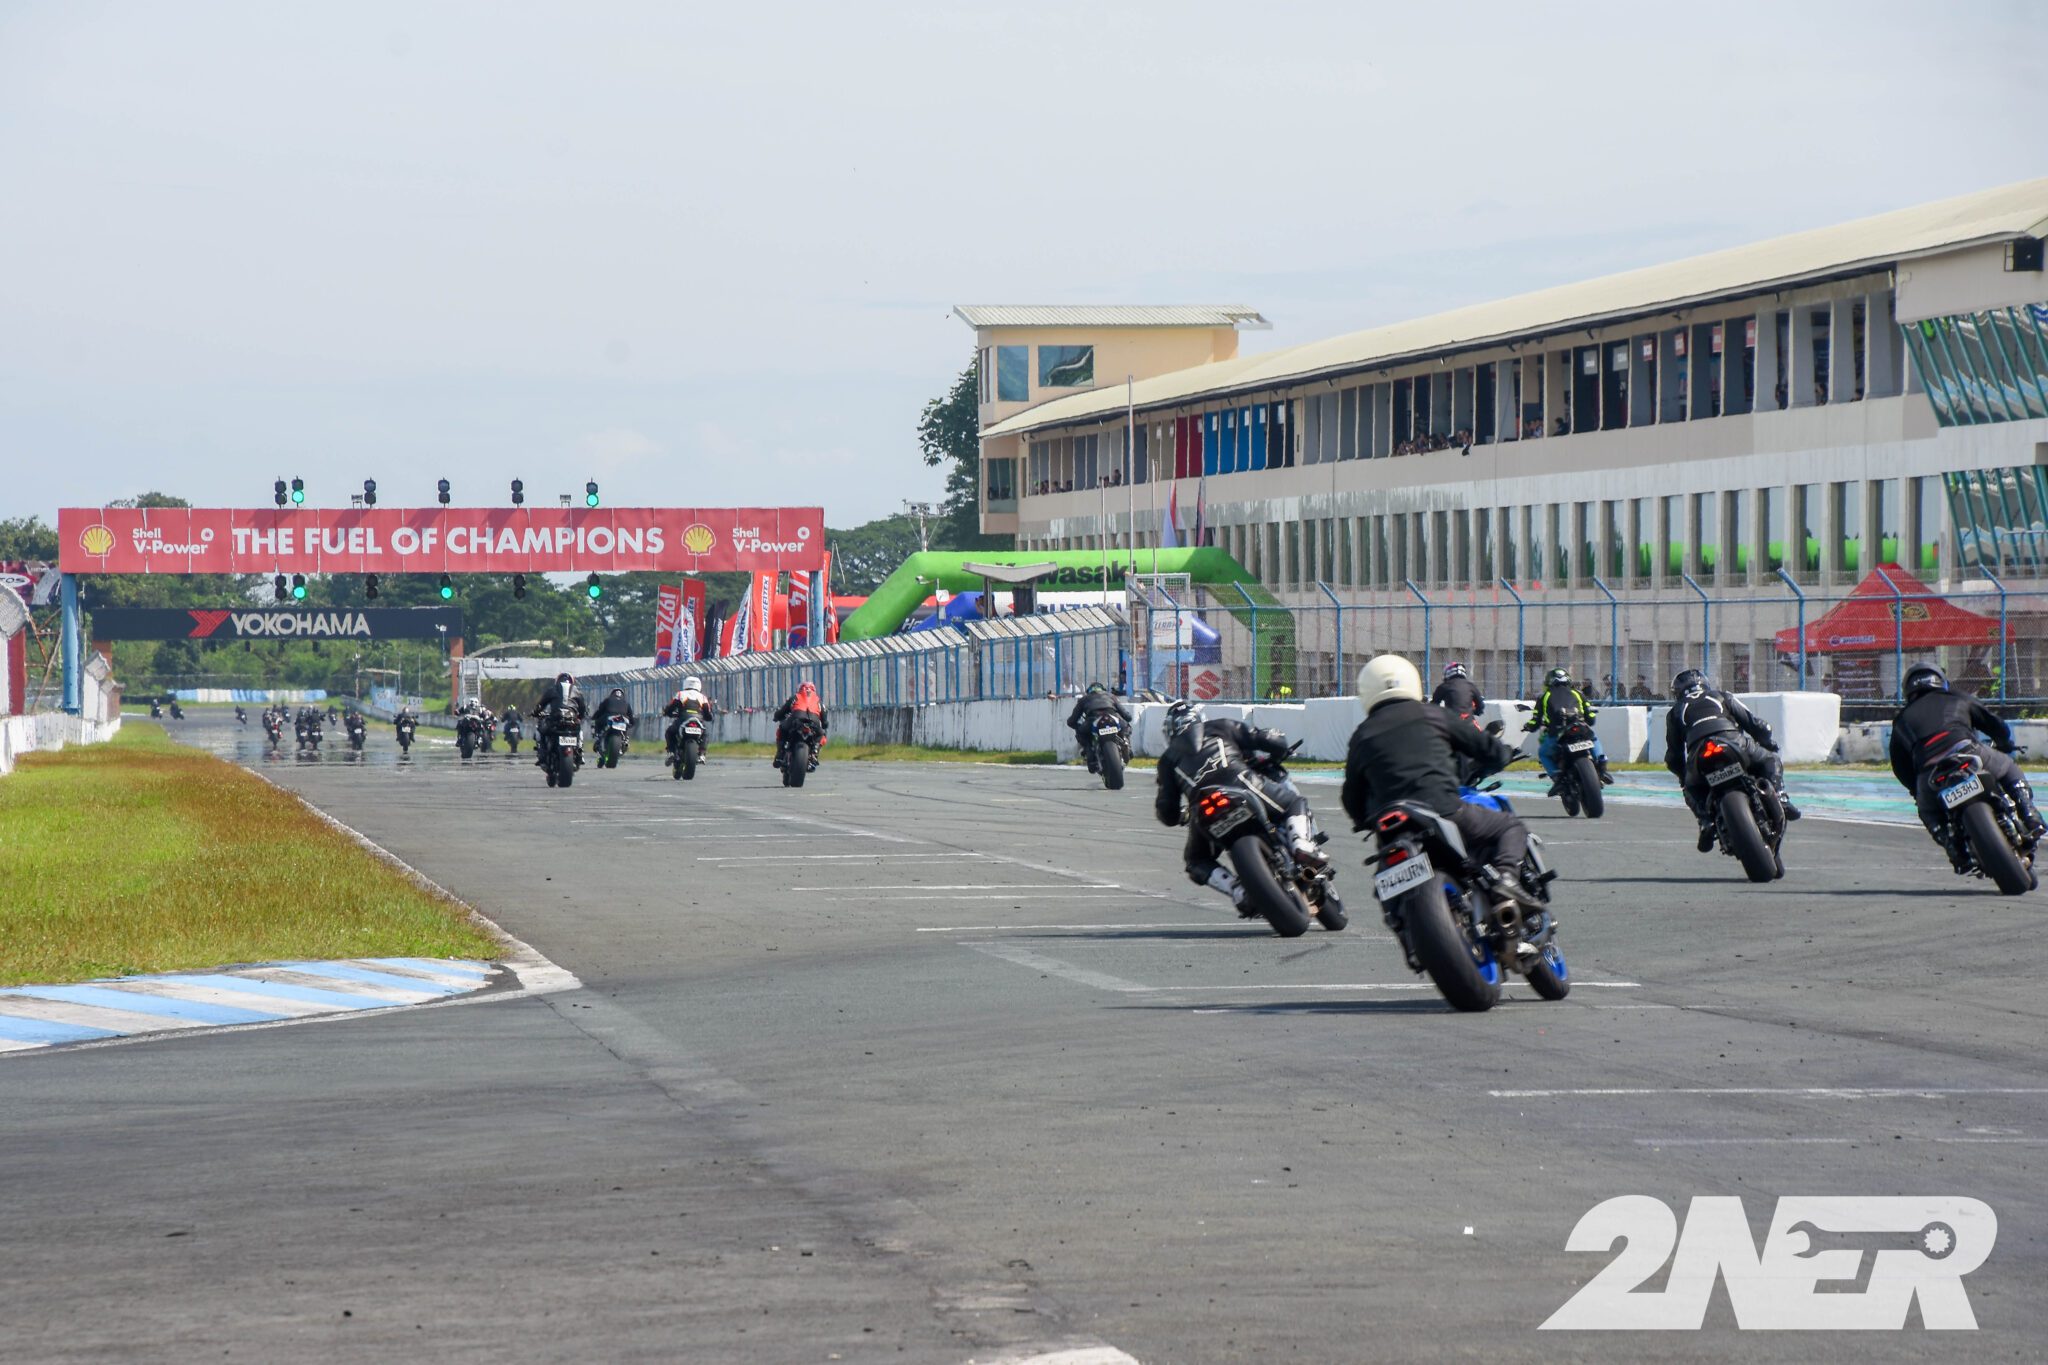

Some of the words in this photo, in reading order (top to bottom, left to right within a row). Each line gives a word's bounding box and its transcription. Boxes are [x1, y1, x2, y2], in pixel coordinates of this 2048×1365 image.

[132, 527, 161, 539] Shell
[232, 528, 294, 555] THE
[305, 527, 382, 555] FUEL
[391, 527, 438, 554] OF
[446, 526, 664, 554] CHAMPIONS
[732, 527, 759, 539] Shell
[133, 540, 208, 555] V-Power
[733, 539, 805, 553] V-Power
[995, 559, 1138, 585] wasaki
[657, 592, 676, 633] 1974
[231, 612, 371, 636] YOKOHAMA
